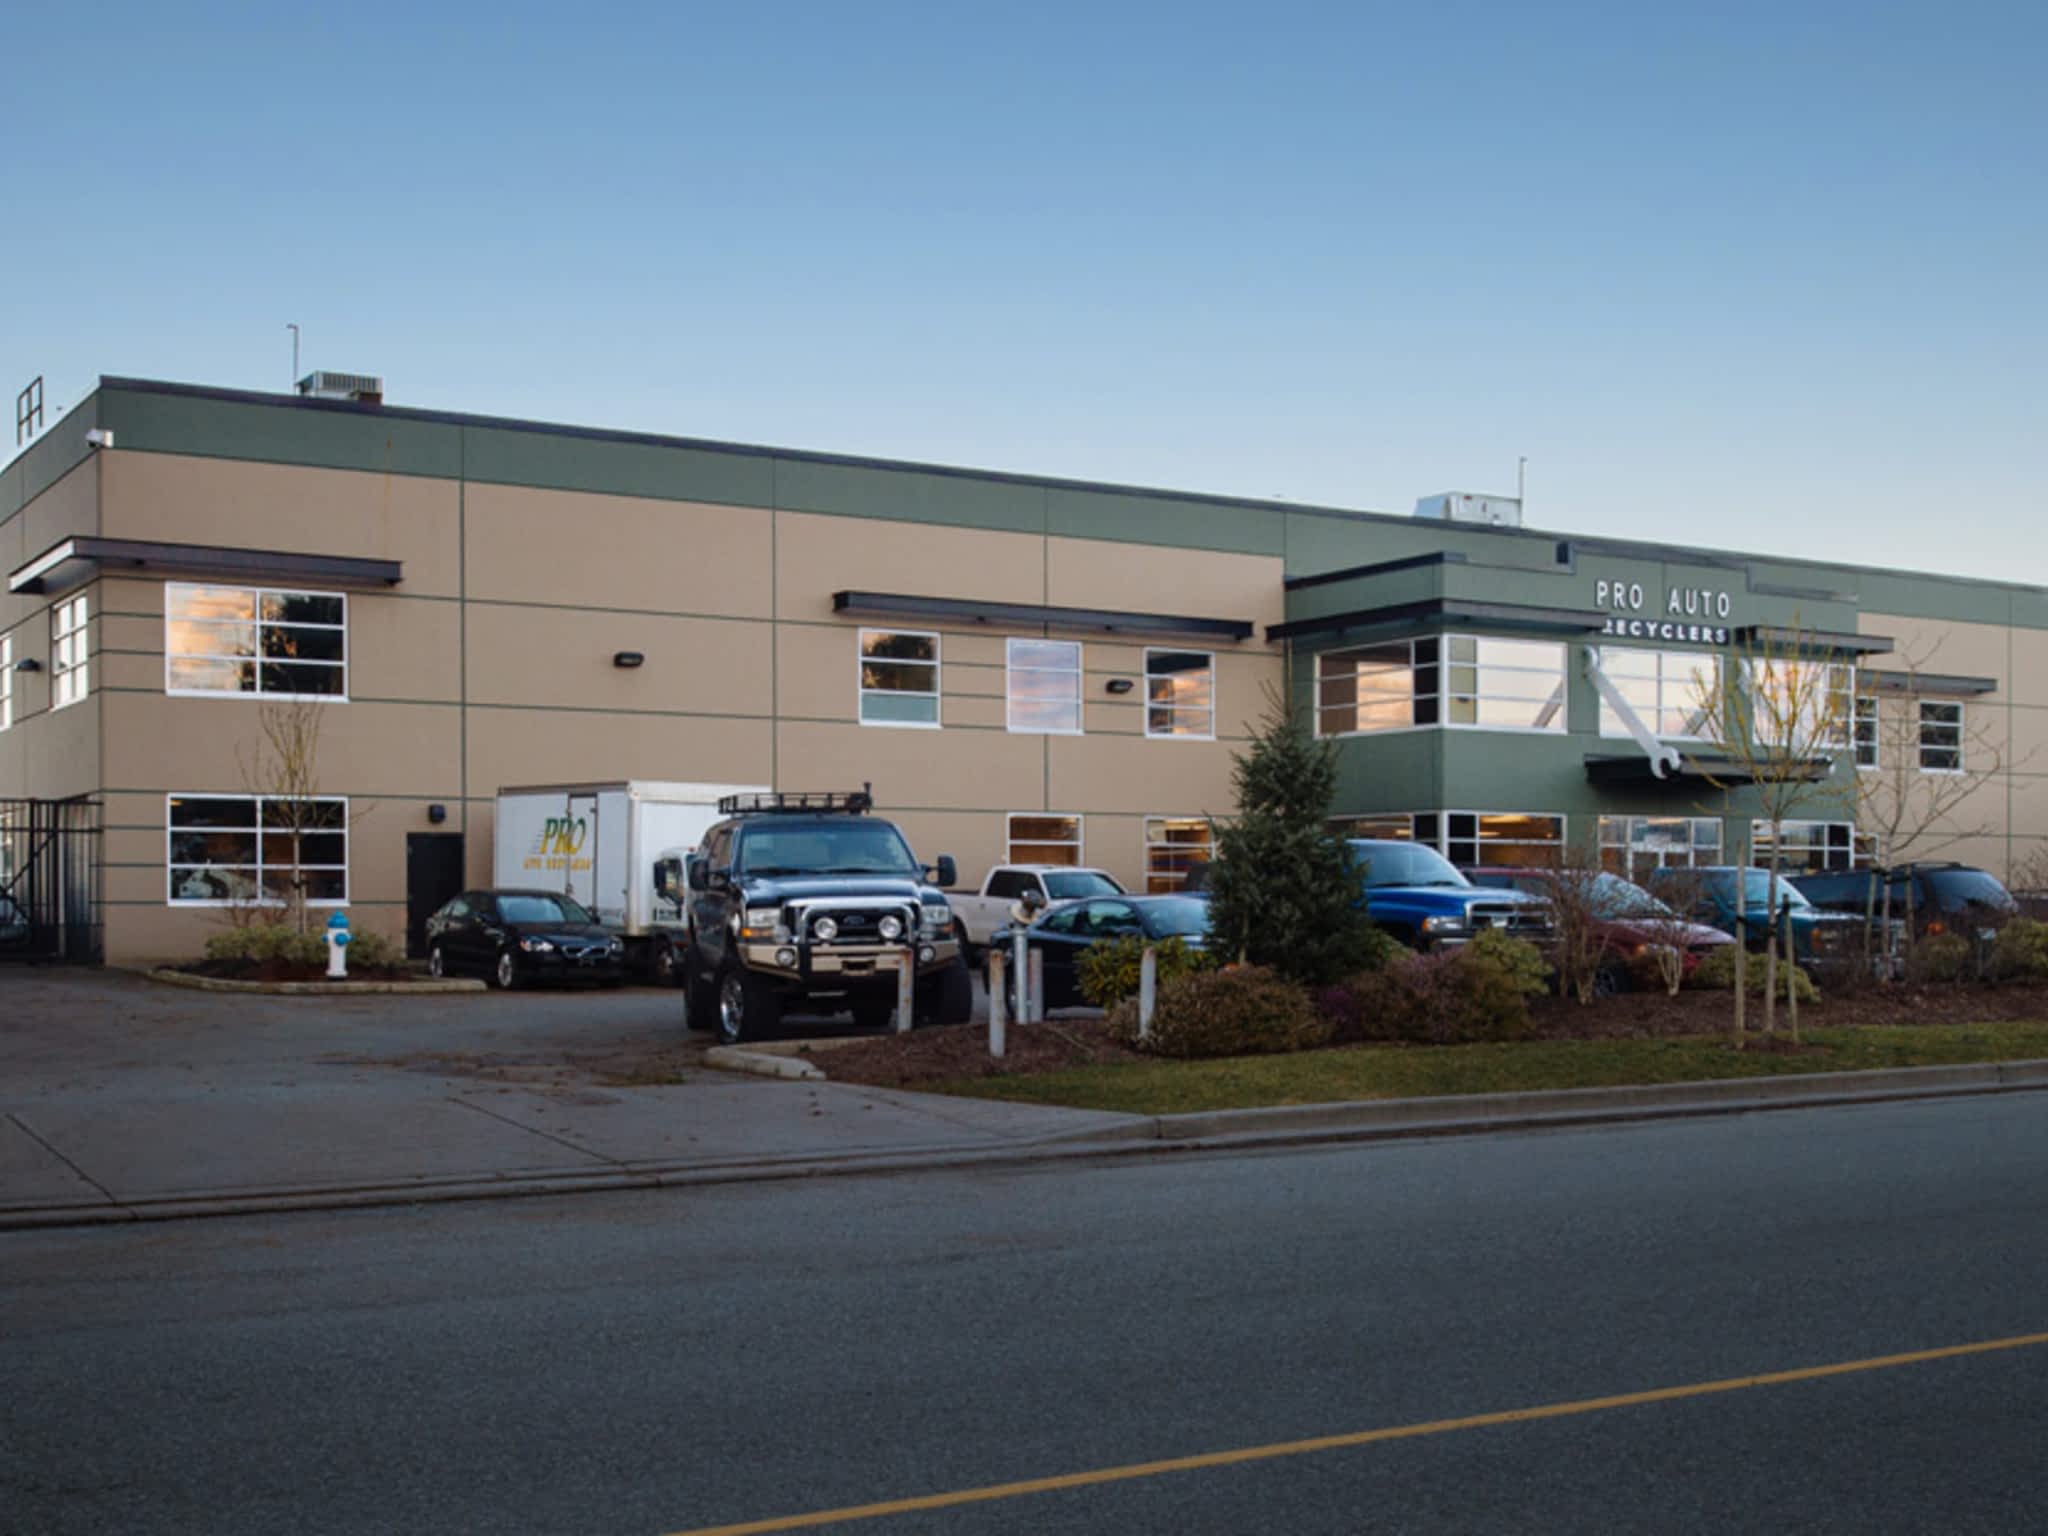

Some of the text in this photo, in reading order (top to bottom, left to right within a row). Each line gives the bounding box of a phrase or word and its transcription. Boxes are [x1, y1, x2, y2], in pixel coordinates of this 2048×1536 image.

[1596, 580, 1730, 618] PRO AUTO
[539, 817, 586, 855] PRO
